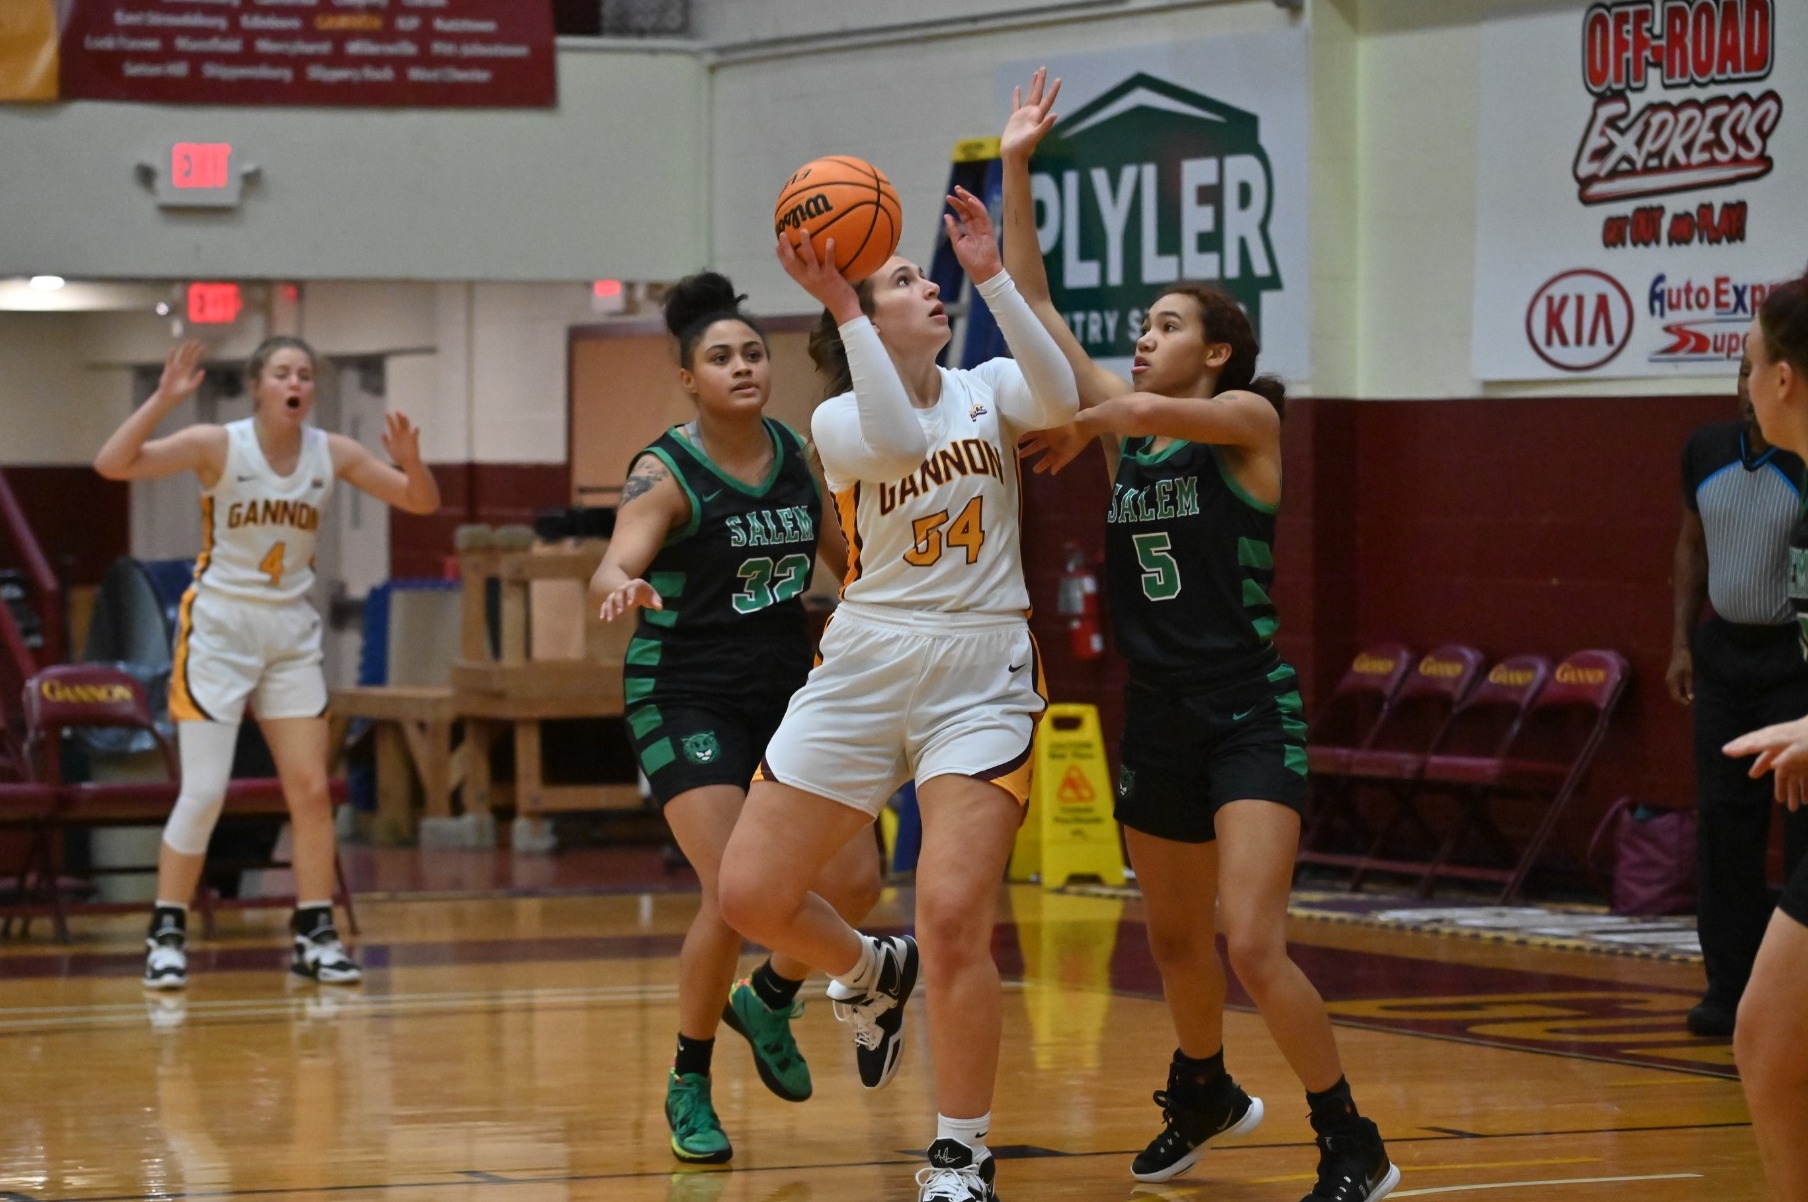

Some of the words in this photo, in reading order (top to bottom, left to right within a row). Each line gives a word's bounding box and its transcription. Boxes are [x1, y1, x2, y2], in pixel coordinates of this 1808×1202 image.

[1584, 0, 1773, 94] OFF-ROAD
[1575, 92, 1781, 183] EXPRESS
[1030, 154, 1271, 289] PLYLER
[1545, 292, 1614, 348] KIA
[879, 439, 1004, 516] GANNON
[1107, 476, 1200, 523] SALEM
[725, 505, 814, 547] SALEM
[903, 495, 985, 566] 54
[258, 540, 285, 585] 4
[732, 553, 810, 614] 32
[1132, 532, 1181, 602] 5
